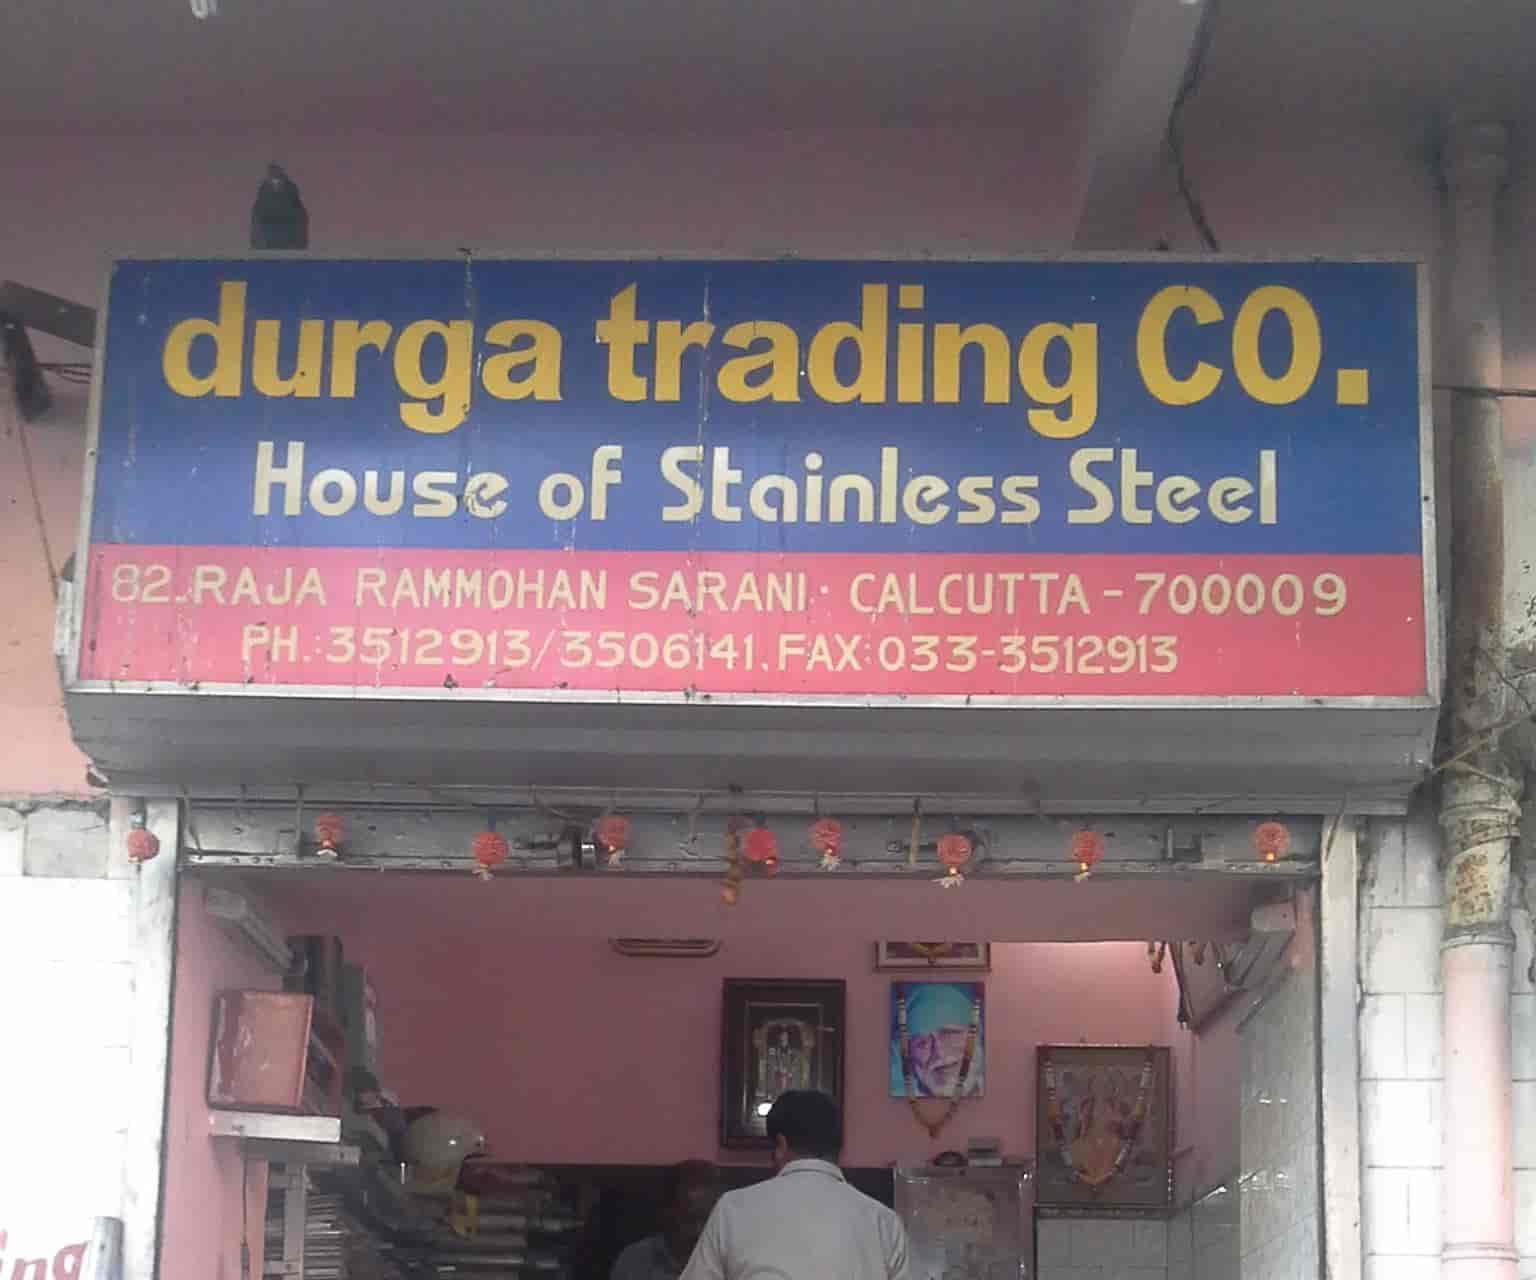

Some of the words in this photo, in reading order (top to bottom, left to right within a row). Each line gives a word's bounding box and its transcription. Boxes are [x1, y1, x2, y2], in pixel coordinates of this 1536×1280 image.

[161, 280, 564, 434] durga
[595, 282, 1100, 440] trading
[1135, 285, 1369, 406] CO.
[252, 441, 508, 518] House
[537, 445, 623, 521] of
[658, 445, 1042, 525] Stainless
[1066, 447, 1279, 525] Steel
[354, 567, 607, 609] RAMMOHAN
[850, 571, 1091, 616] CALCUTTA
[1135, 573, 1348, 617] 700009
